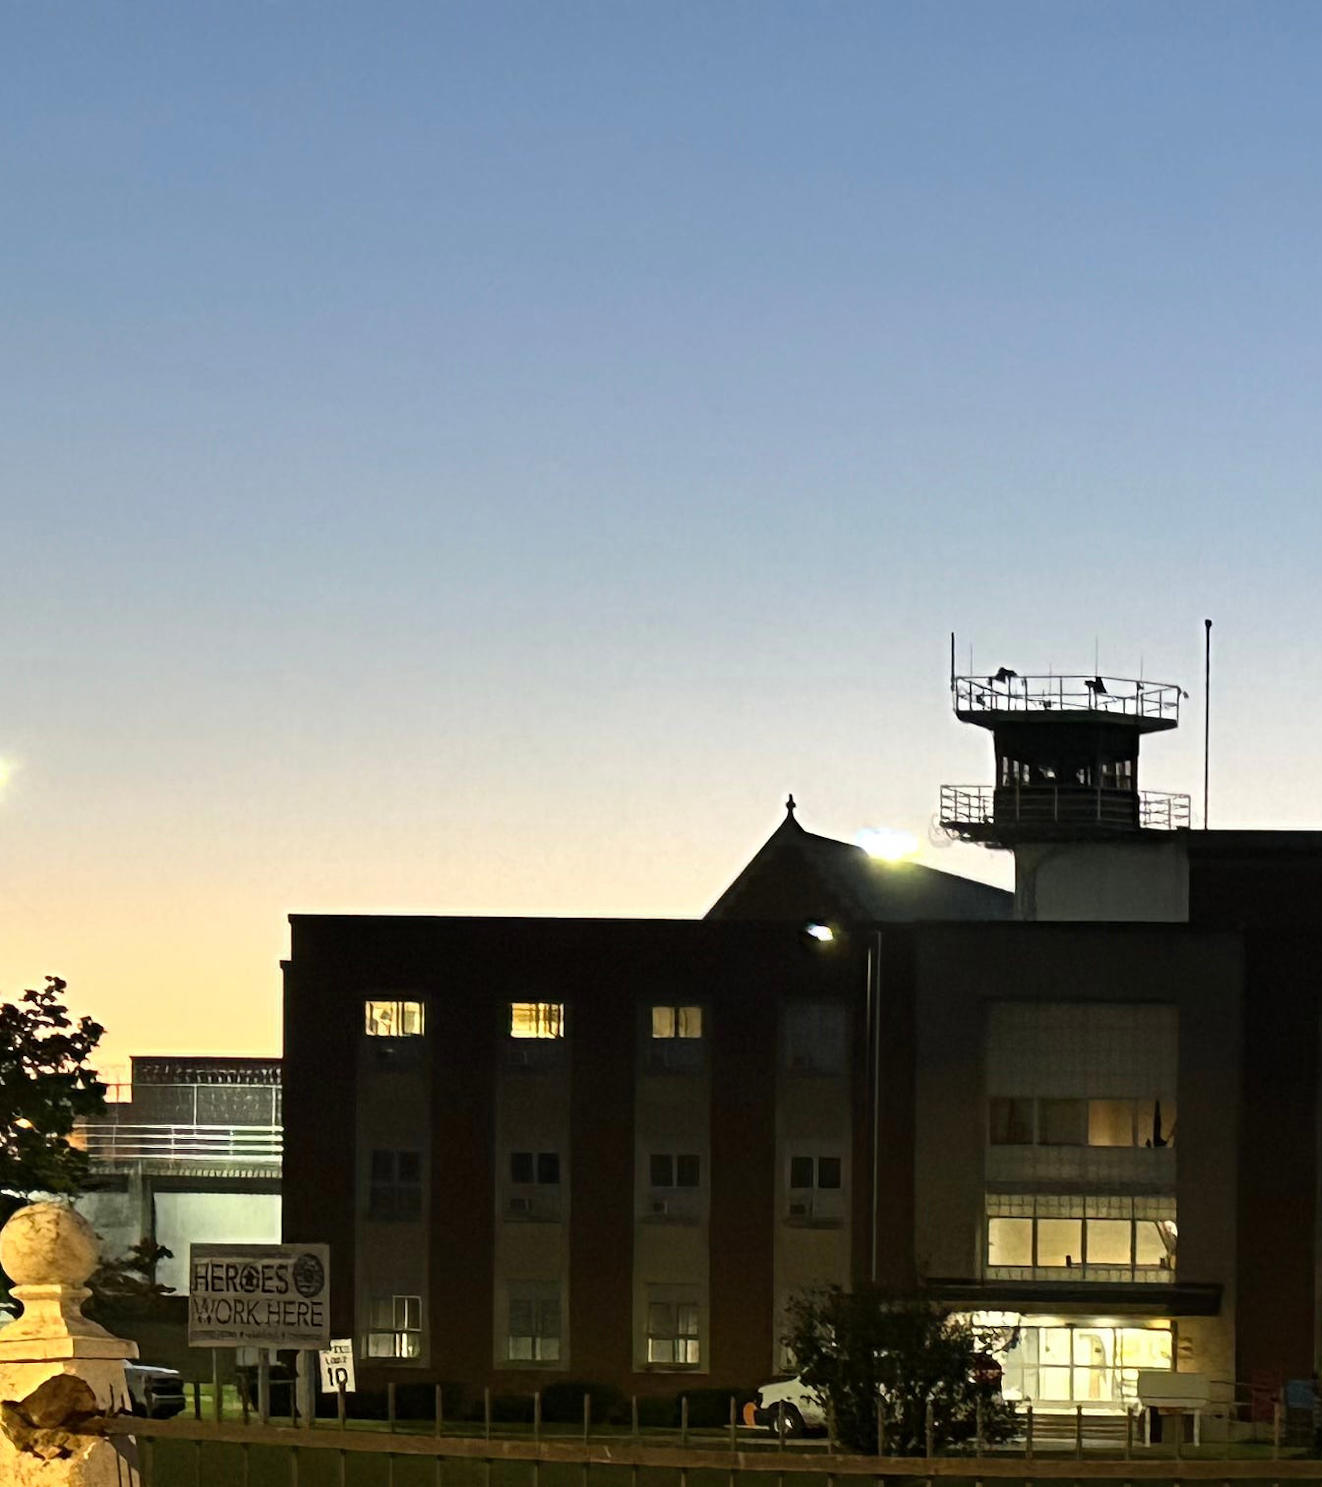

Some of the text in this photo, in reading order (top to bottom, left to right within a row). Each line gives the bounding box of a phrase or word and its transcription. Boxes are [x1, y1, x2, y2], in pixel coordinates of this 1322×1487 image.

[193, 1263, 289, 1294] HEROES
[192, 1299, 323, 1327] WORK HERE
[328, 1368, 348, 1386] 10
